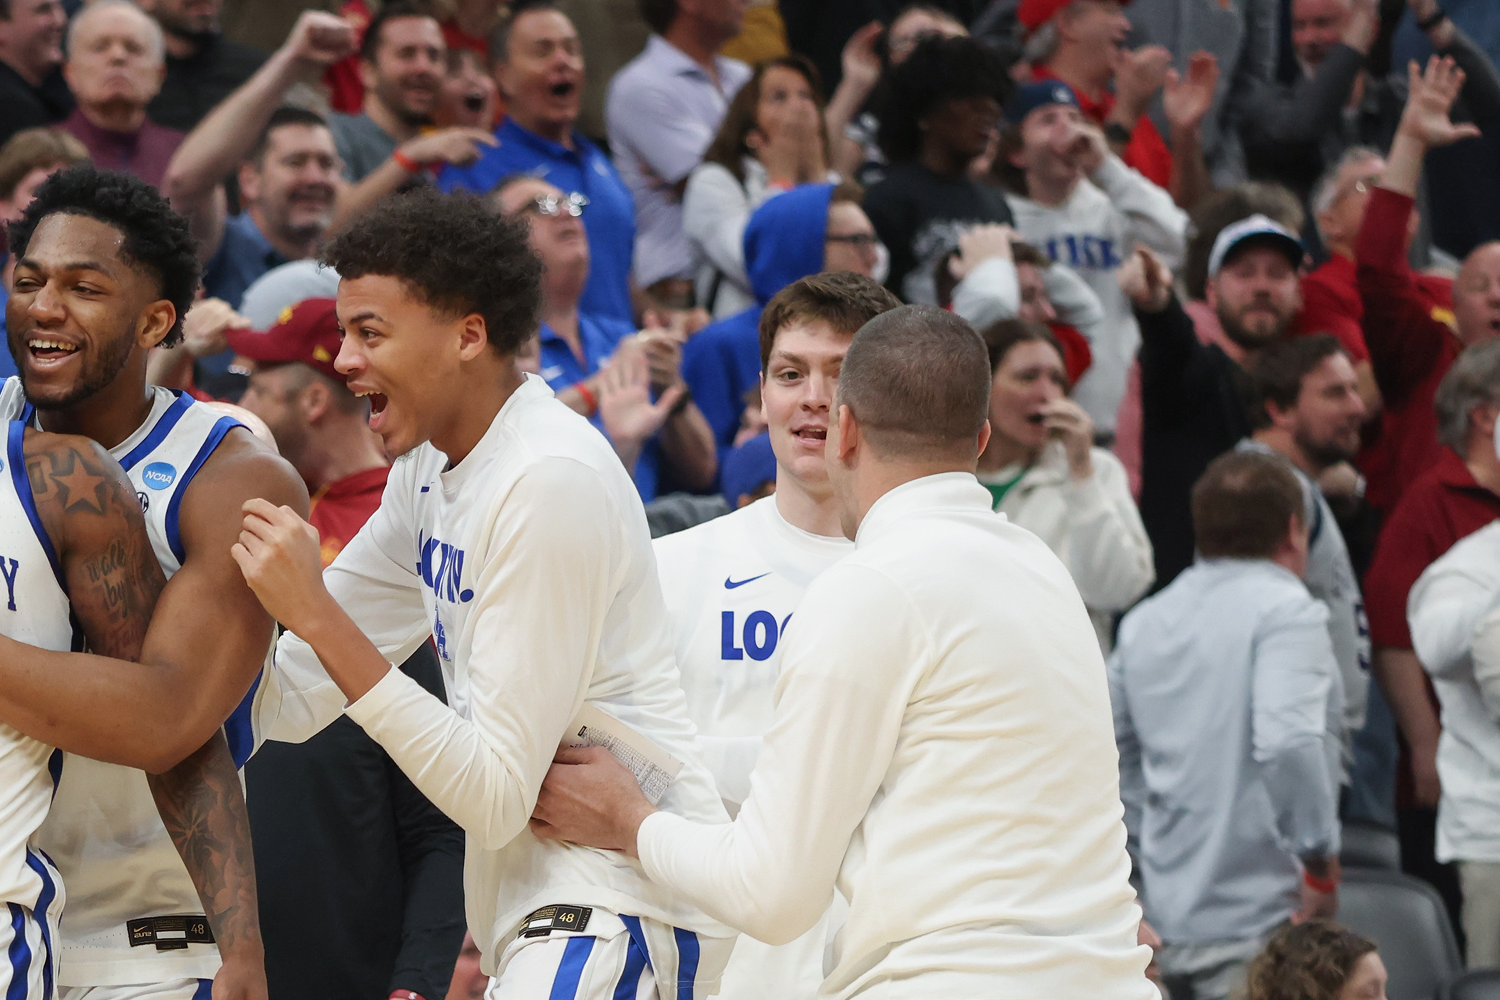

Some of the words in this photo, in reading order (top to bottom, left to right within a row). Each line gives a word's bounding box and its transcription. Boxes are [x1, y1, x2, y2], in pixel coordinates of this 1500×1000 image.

[145, 470, 173, 483] NCAA
[721, 610, 794, 662] LO
[559, 912, 575, 923] 48
[190, 923, 204, 935] 48
